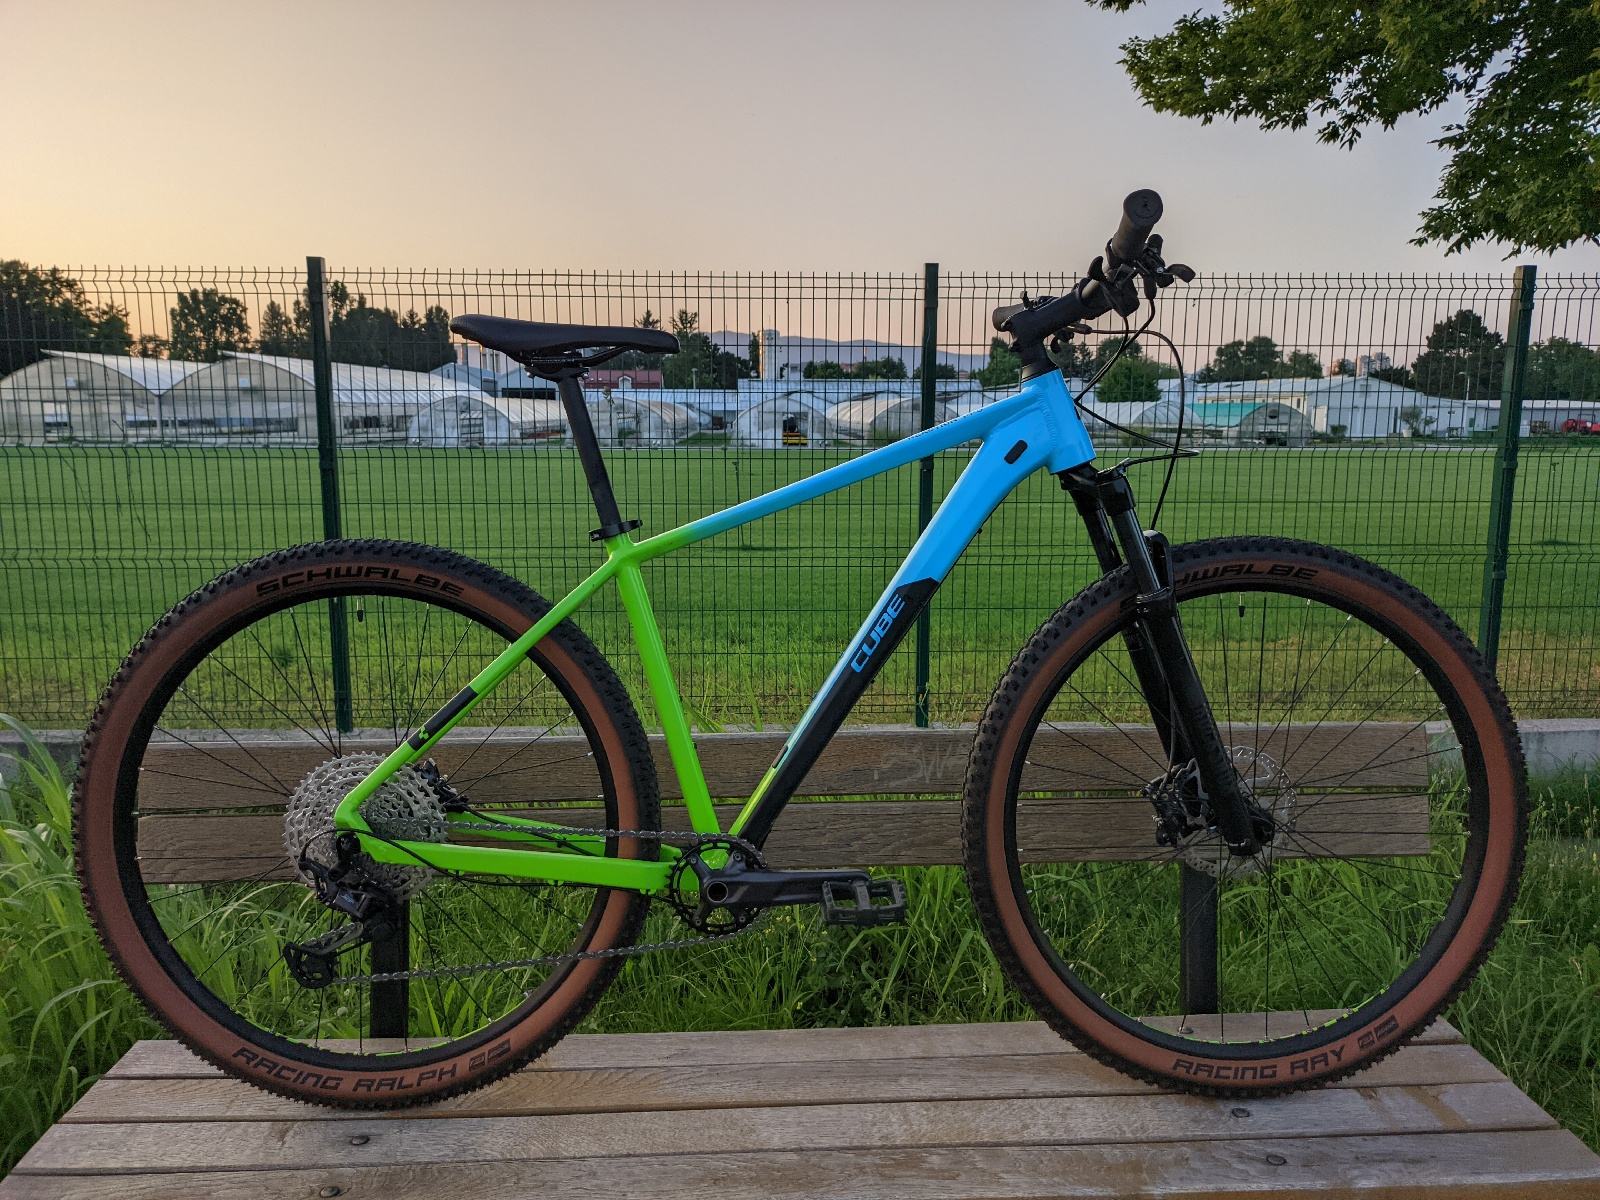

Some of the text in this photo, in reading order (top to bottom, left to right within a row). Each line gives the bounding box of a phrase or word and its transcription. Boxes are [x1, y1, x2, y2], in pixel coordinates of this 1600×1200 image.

[256, 565, 465, 597] SCHWALBE
[1174, 563, 1320, 586] HWALBE
[851, 593, 906, 673] CUBE
[232, 1046, 458, 1093] RACING RALPH
[1172, 1044, 1346, 1080] RACING RAY
